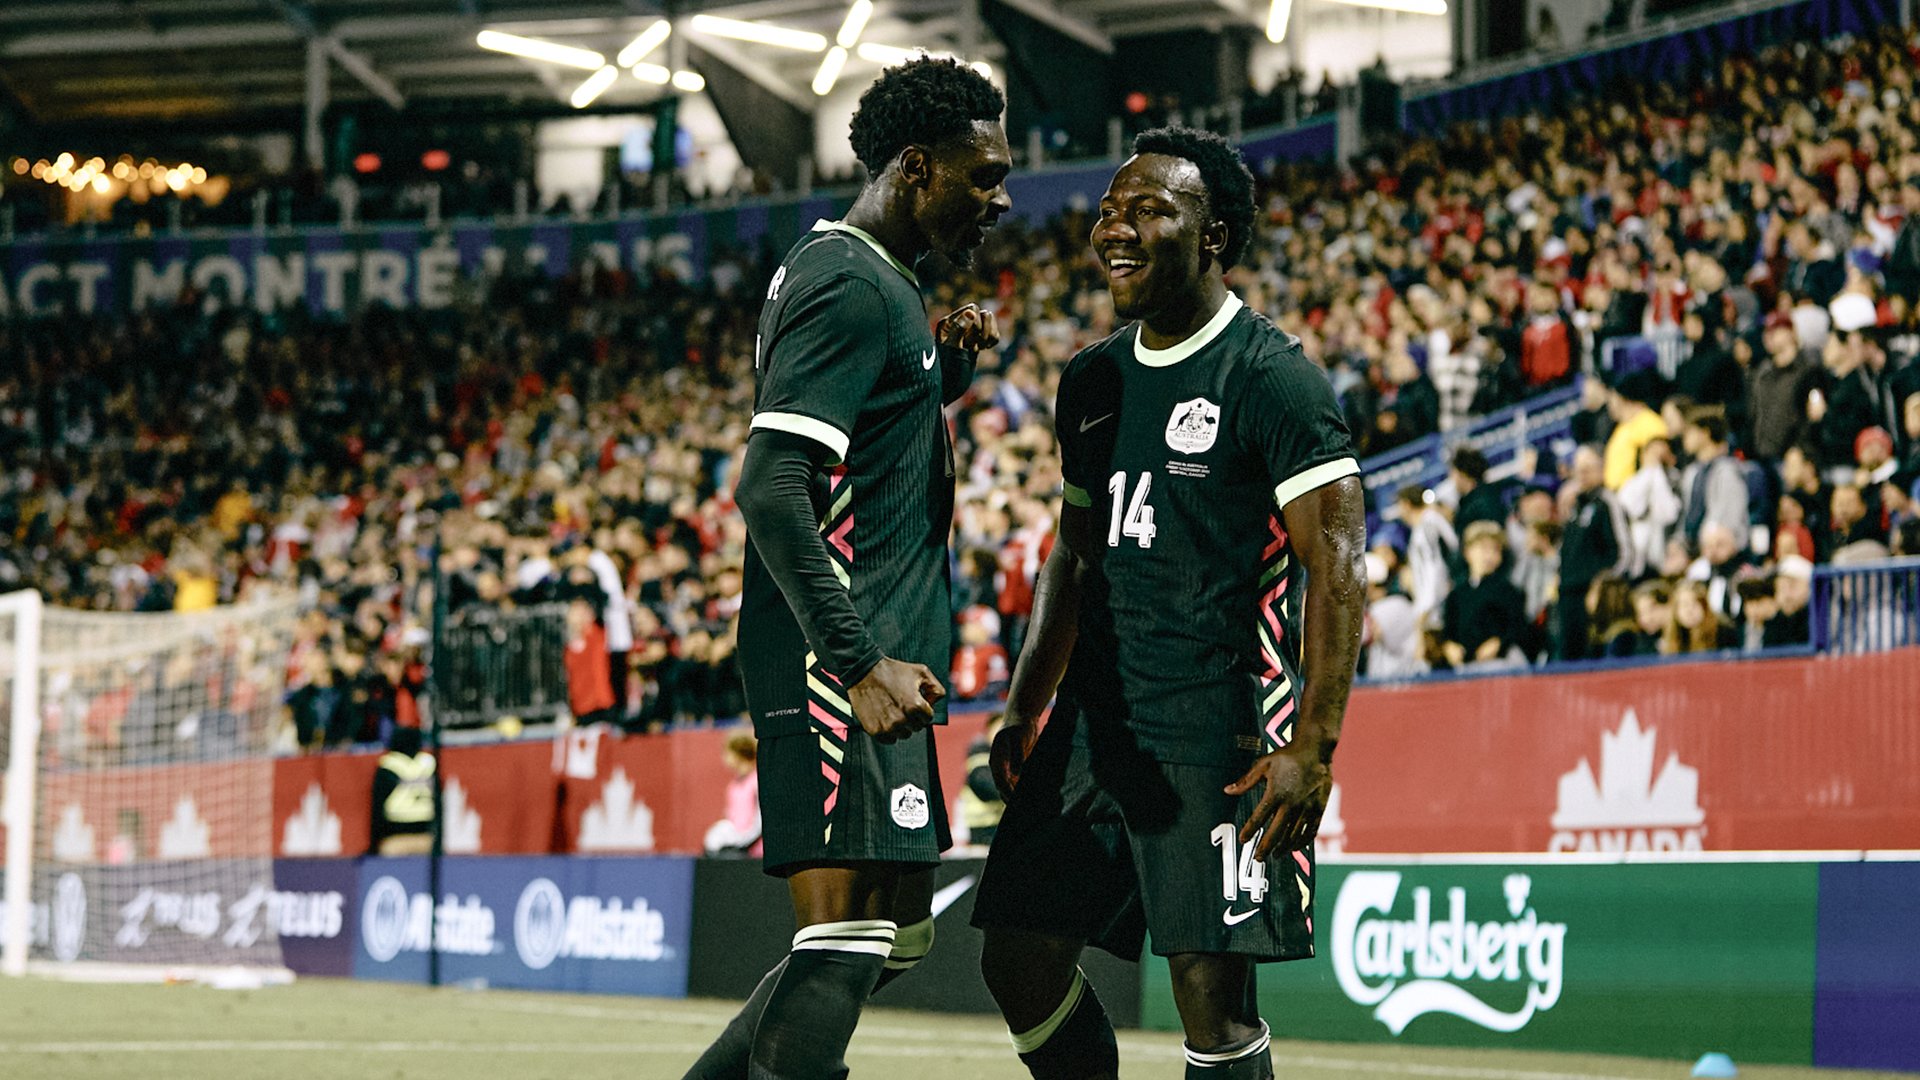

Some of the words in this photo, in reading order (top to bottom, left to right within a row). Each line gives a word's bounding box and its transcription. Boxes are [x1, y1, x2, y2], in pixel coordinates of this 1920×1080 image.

[0, 262, 109, 316] CT
[1108, 470, 1157, 549] 14
[1210, 822, 1269, 904] 14
[400, 892, 498, 955] Alstate
[556, 895, 665, 961] Allstate
[1331, 871, 1567, 1012] Carlsberg
